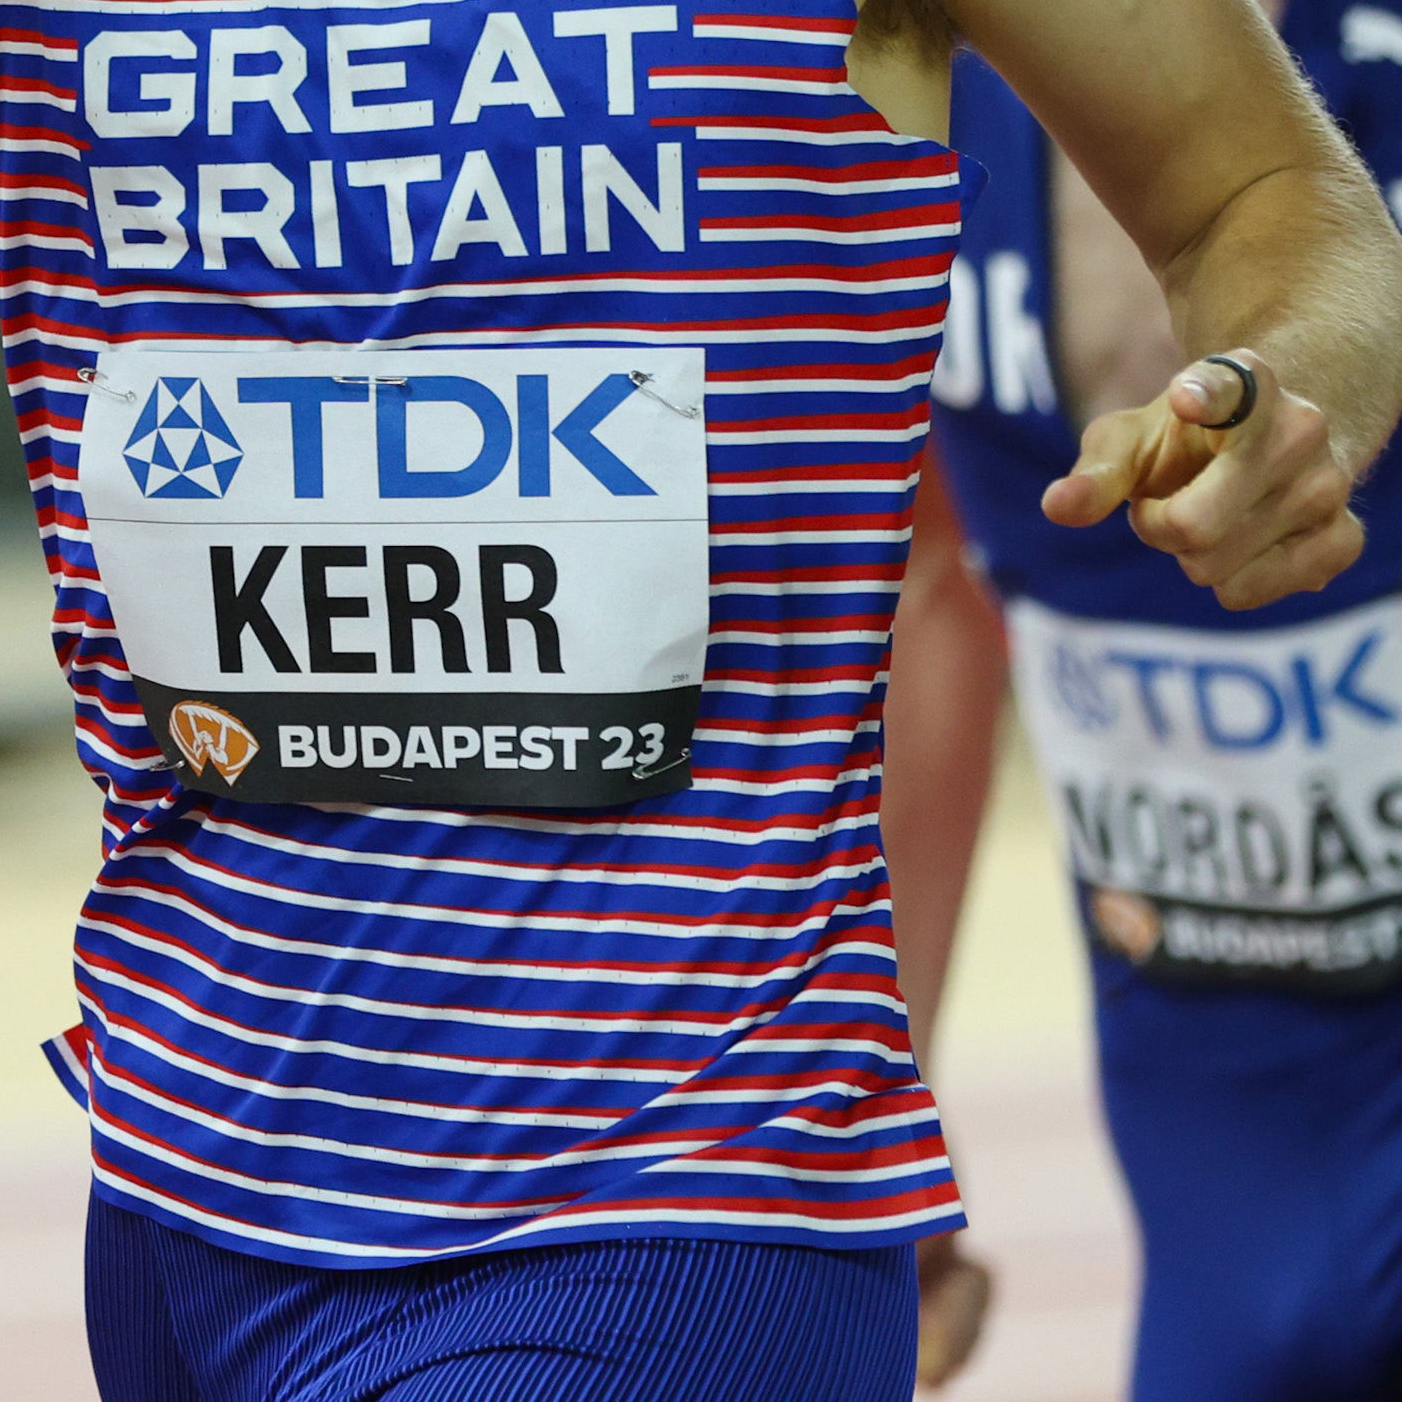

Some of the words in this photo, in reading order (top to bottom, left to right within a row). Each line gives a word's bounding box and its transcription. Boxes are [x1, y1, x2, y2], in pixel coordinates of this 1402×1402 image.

[83, 5, 678, 139] GREAT
[89, 142, 686, 270] BRITAIN
[237, 373, 659, 499] TDK
[209, 544, 566, 675] KERR
[278, 725, 589, 770] BUDAPEST
[599, 723, 666, 771] 23
